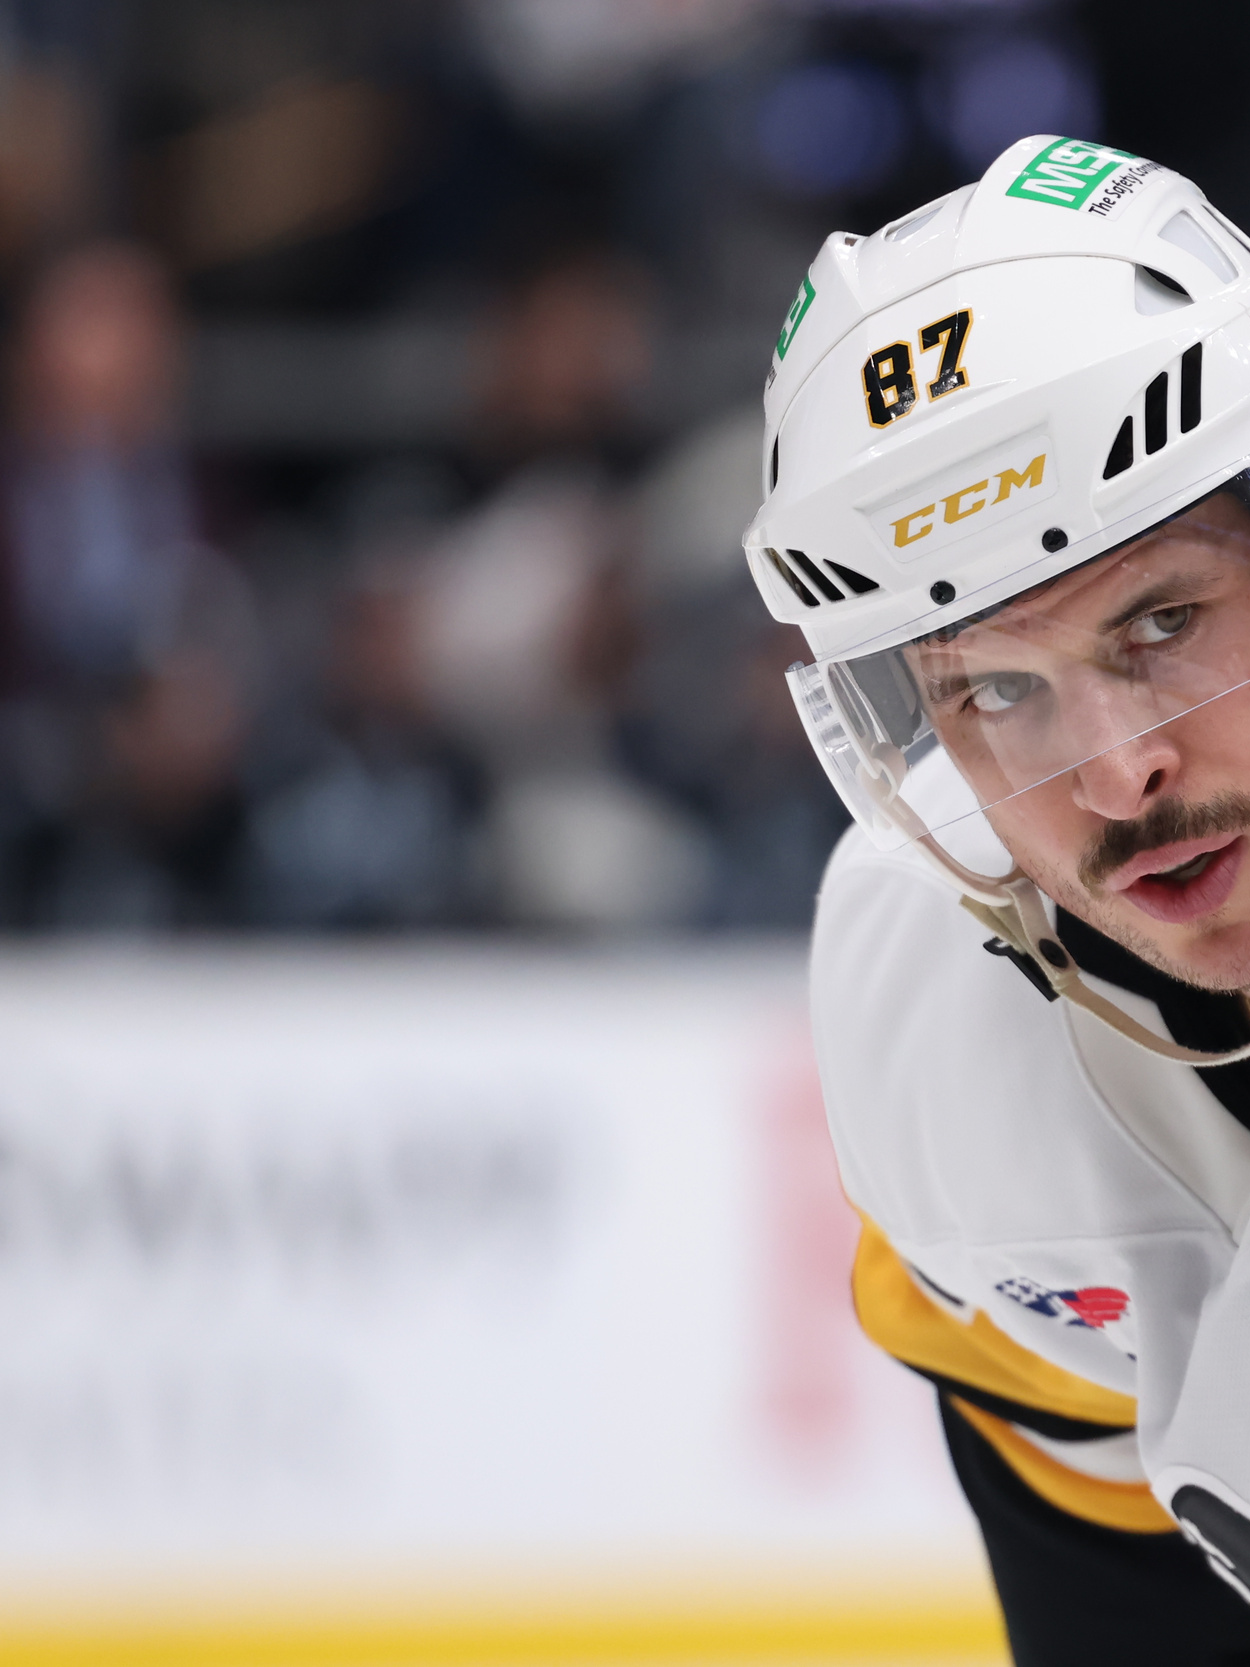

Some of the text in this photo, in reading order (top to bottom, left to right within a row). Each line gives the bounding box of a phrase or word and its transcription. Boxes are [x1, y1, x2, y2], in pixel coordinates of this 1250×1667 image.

[1088, 196, 1117, 217] The
[1104, 172, 1144, 199] Safety
[861, 307, 974, 430] 87
[889, 453, 1047, 549] CCM
